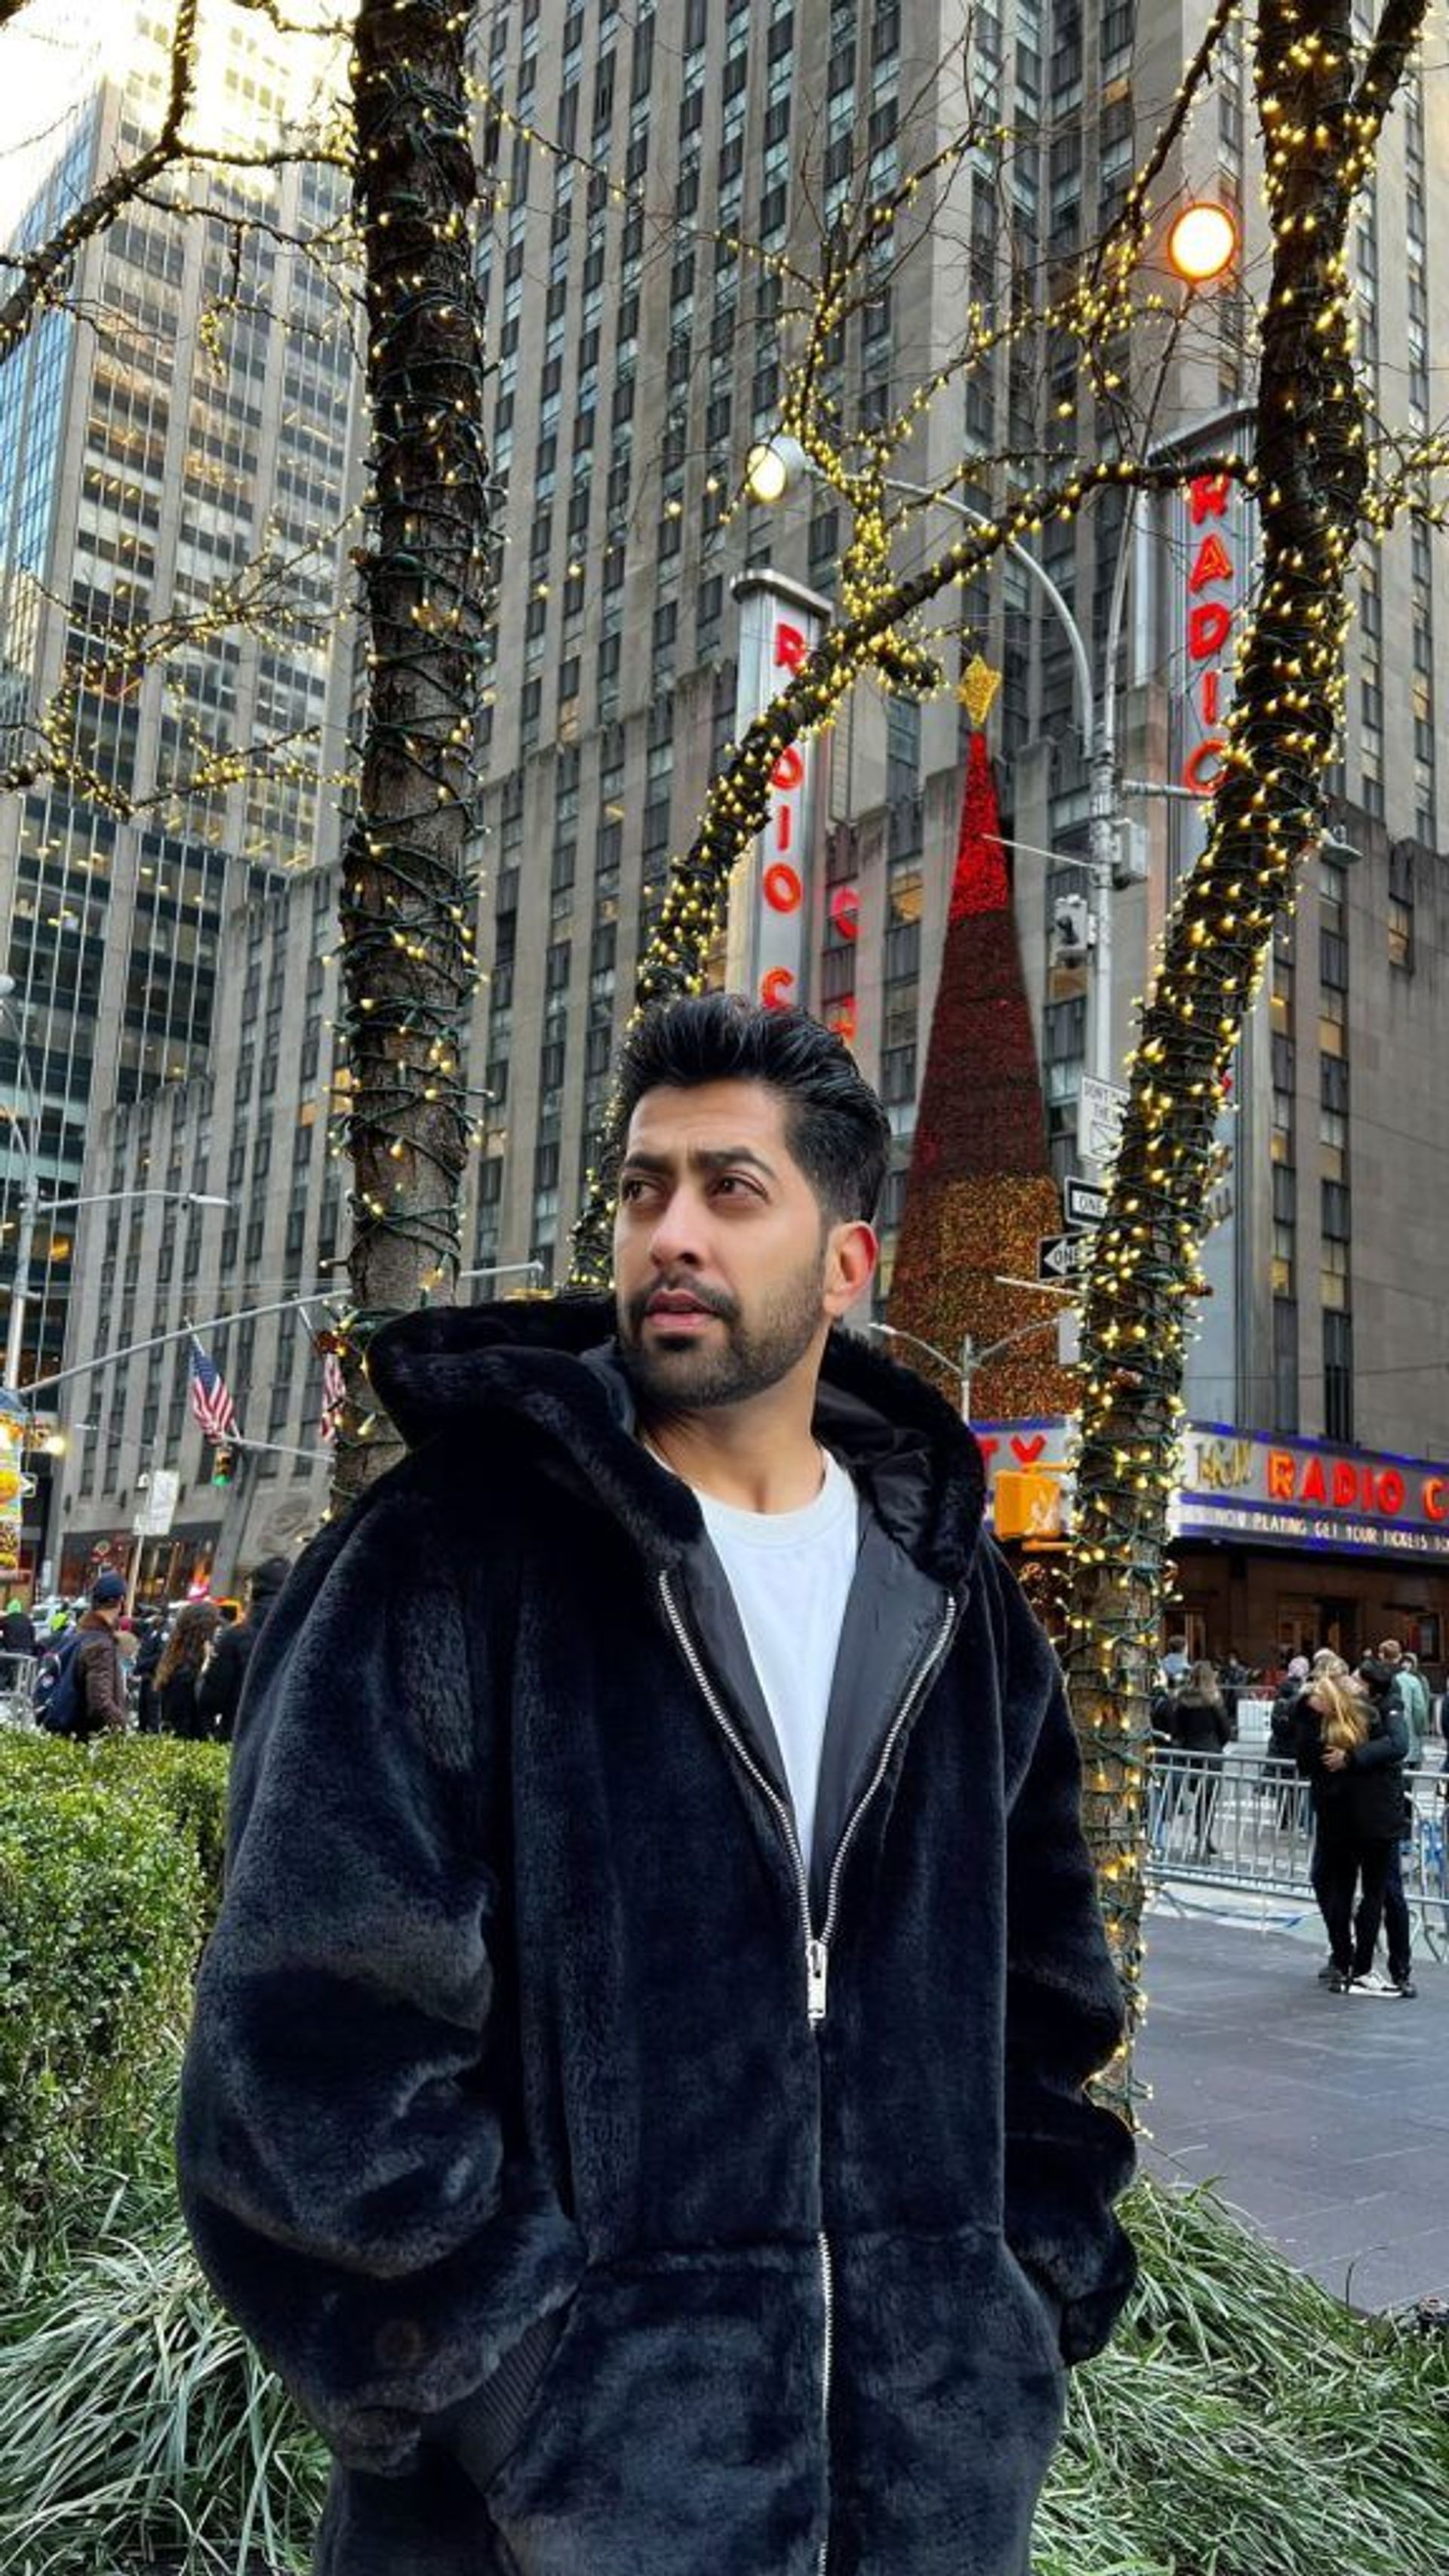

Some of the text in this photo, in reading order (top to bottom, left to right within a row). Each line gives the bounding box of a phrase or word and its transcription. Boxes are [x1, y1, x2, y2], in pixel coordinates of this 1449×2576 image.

[763, 622, 808, 913] RDIO
[1267, 1448, 1405, 1516] RADIO
[1252, 1512, 1308, 1536] PLAYING
[1346, 1524, 1379, 1543] YOUR
[1382, 1529, 1429, 1550] TICKETS
